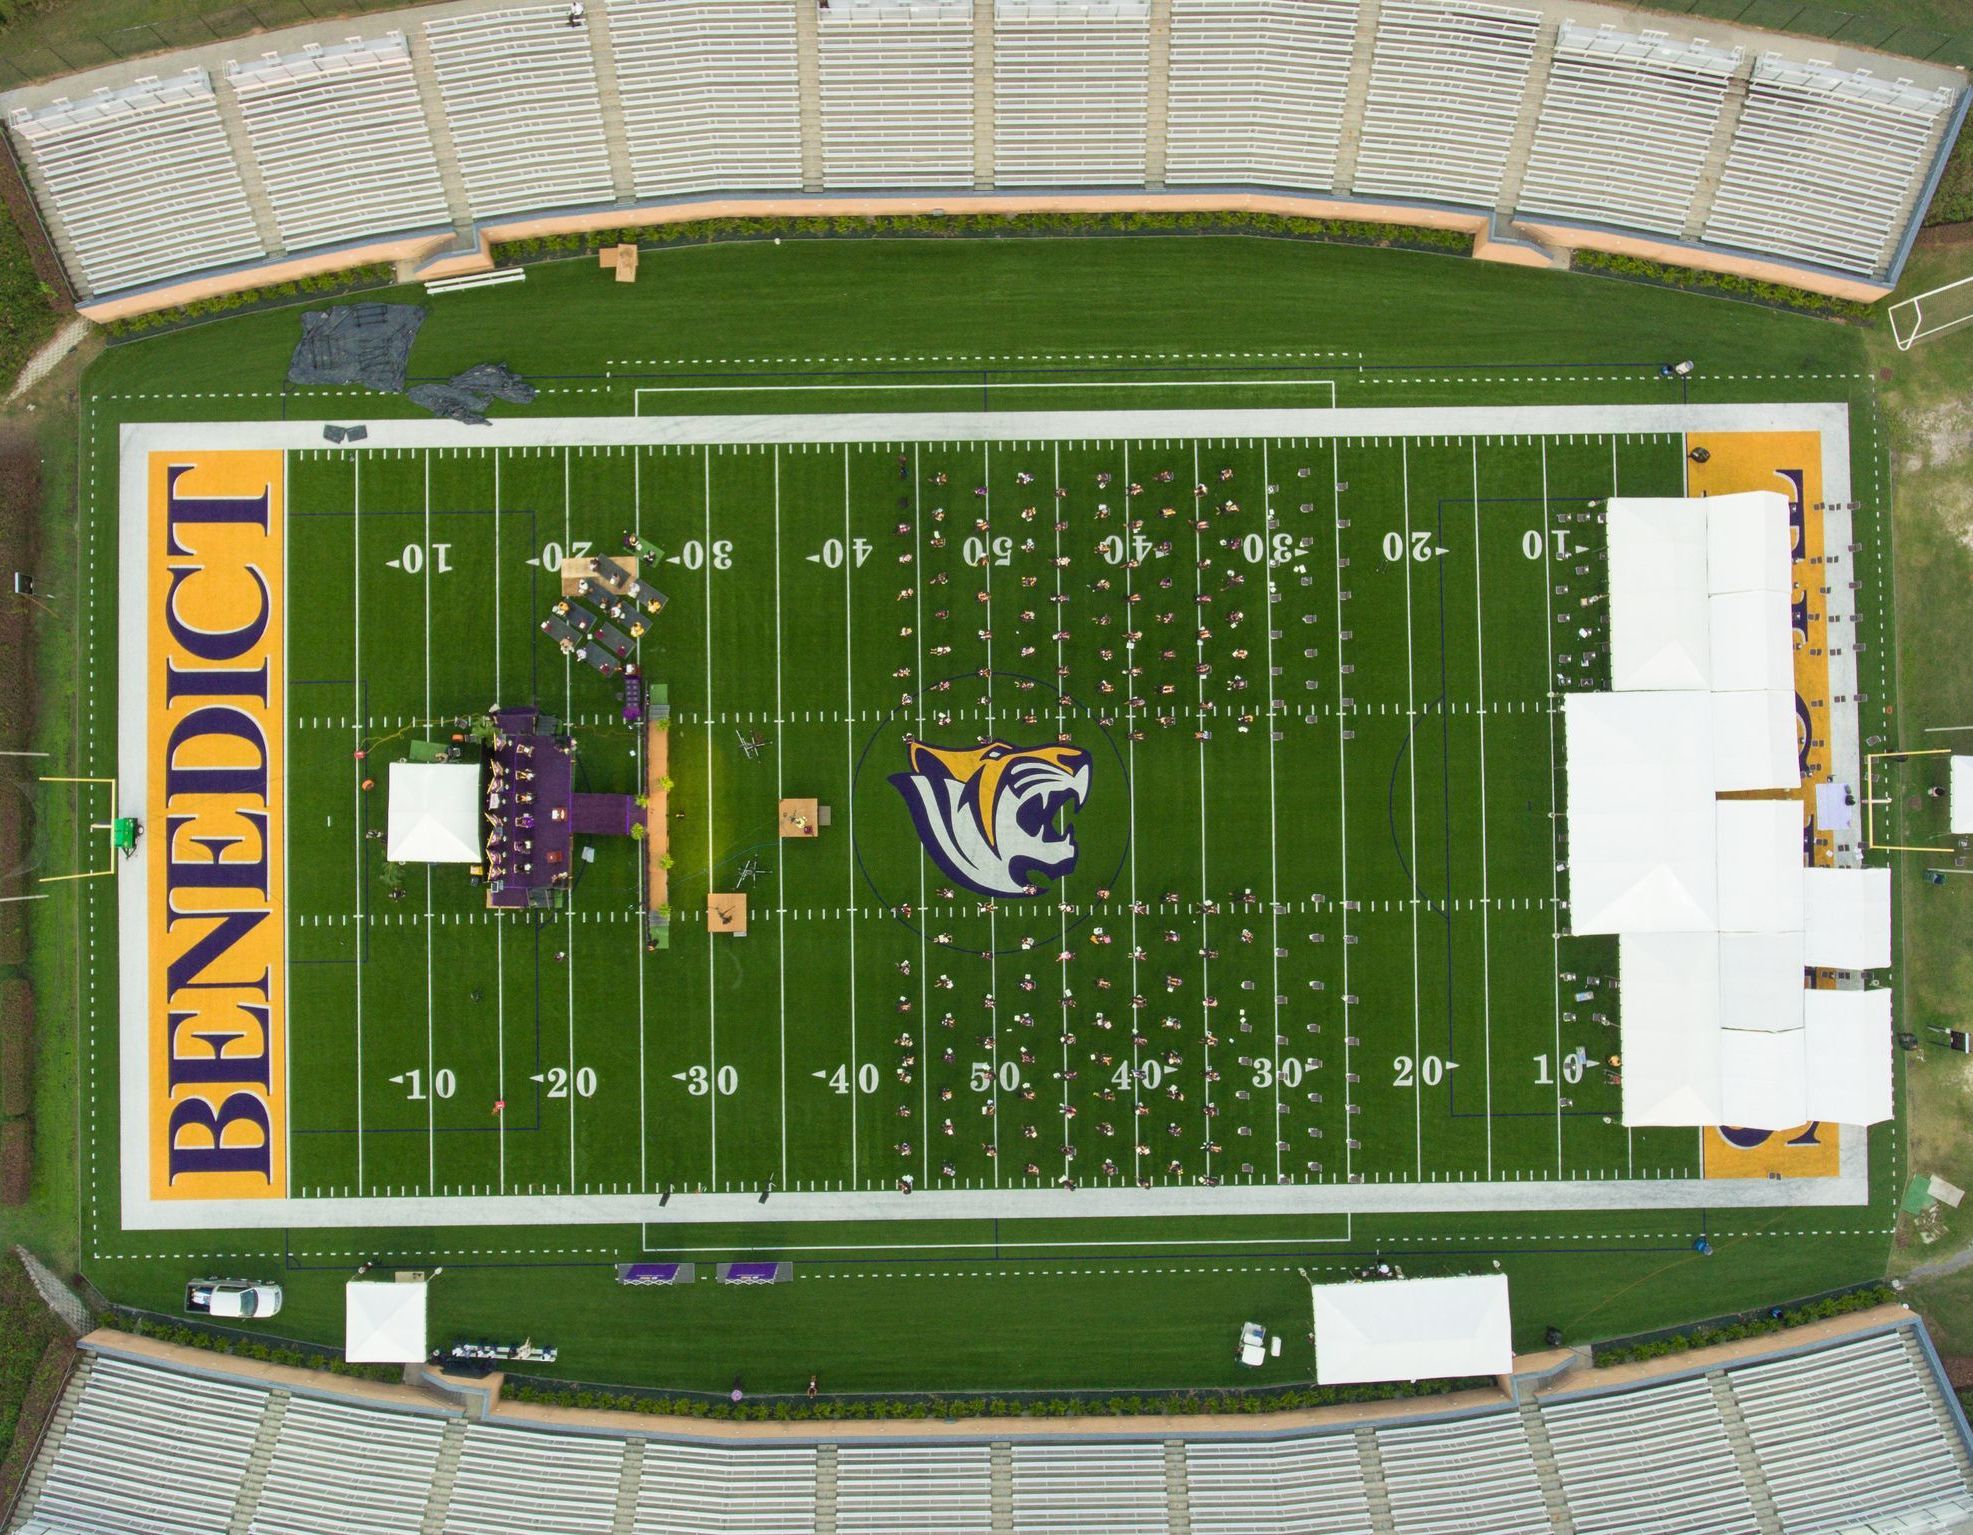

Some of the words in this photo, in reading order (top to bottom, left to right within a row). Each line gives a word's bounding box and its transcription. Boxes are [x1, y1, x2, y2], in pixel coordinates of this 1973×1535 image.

[402, 543, 453, 574] 10
[682, 540, 734, 570] 30
[822, 538, 874, 568] 40
[962, 536, 1013, 567] 50
[1102, 535, 1153, 566] 40
[1242, 533, 1293, 564] 30
[1382, 531, 1432, 562] 20
[1521, 530, 1571, 561] 10
[166, 462, 274, 1187] BENEDICT
[405, 1068, 456, 1100] 10
[546, 1067, 597, 1098] 20
[688, 1065, 739, 1096] 30
[828, 1063, 880, 1094] 40
[969, 1061, 1020, 1092] 50
[1111, 1059, 1162, 1091] 40
[1252, 1057, 1303, 1088] 30
[1392, 1055, 1443, 1087] 20
[1532, 1053, 1583, 1085] 10
